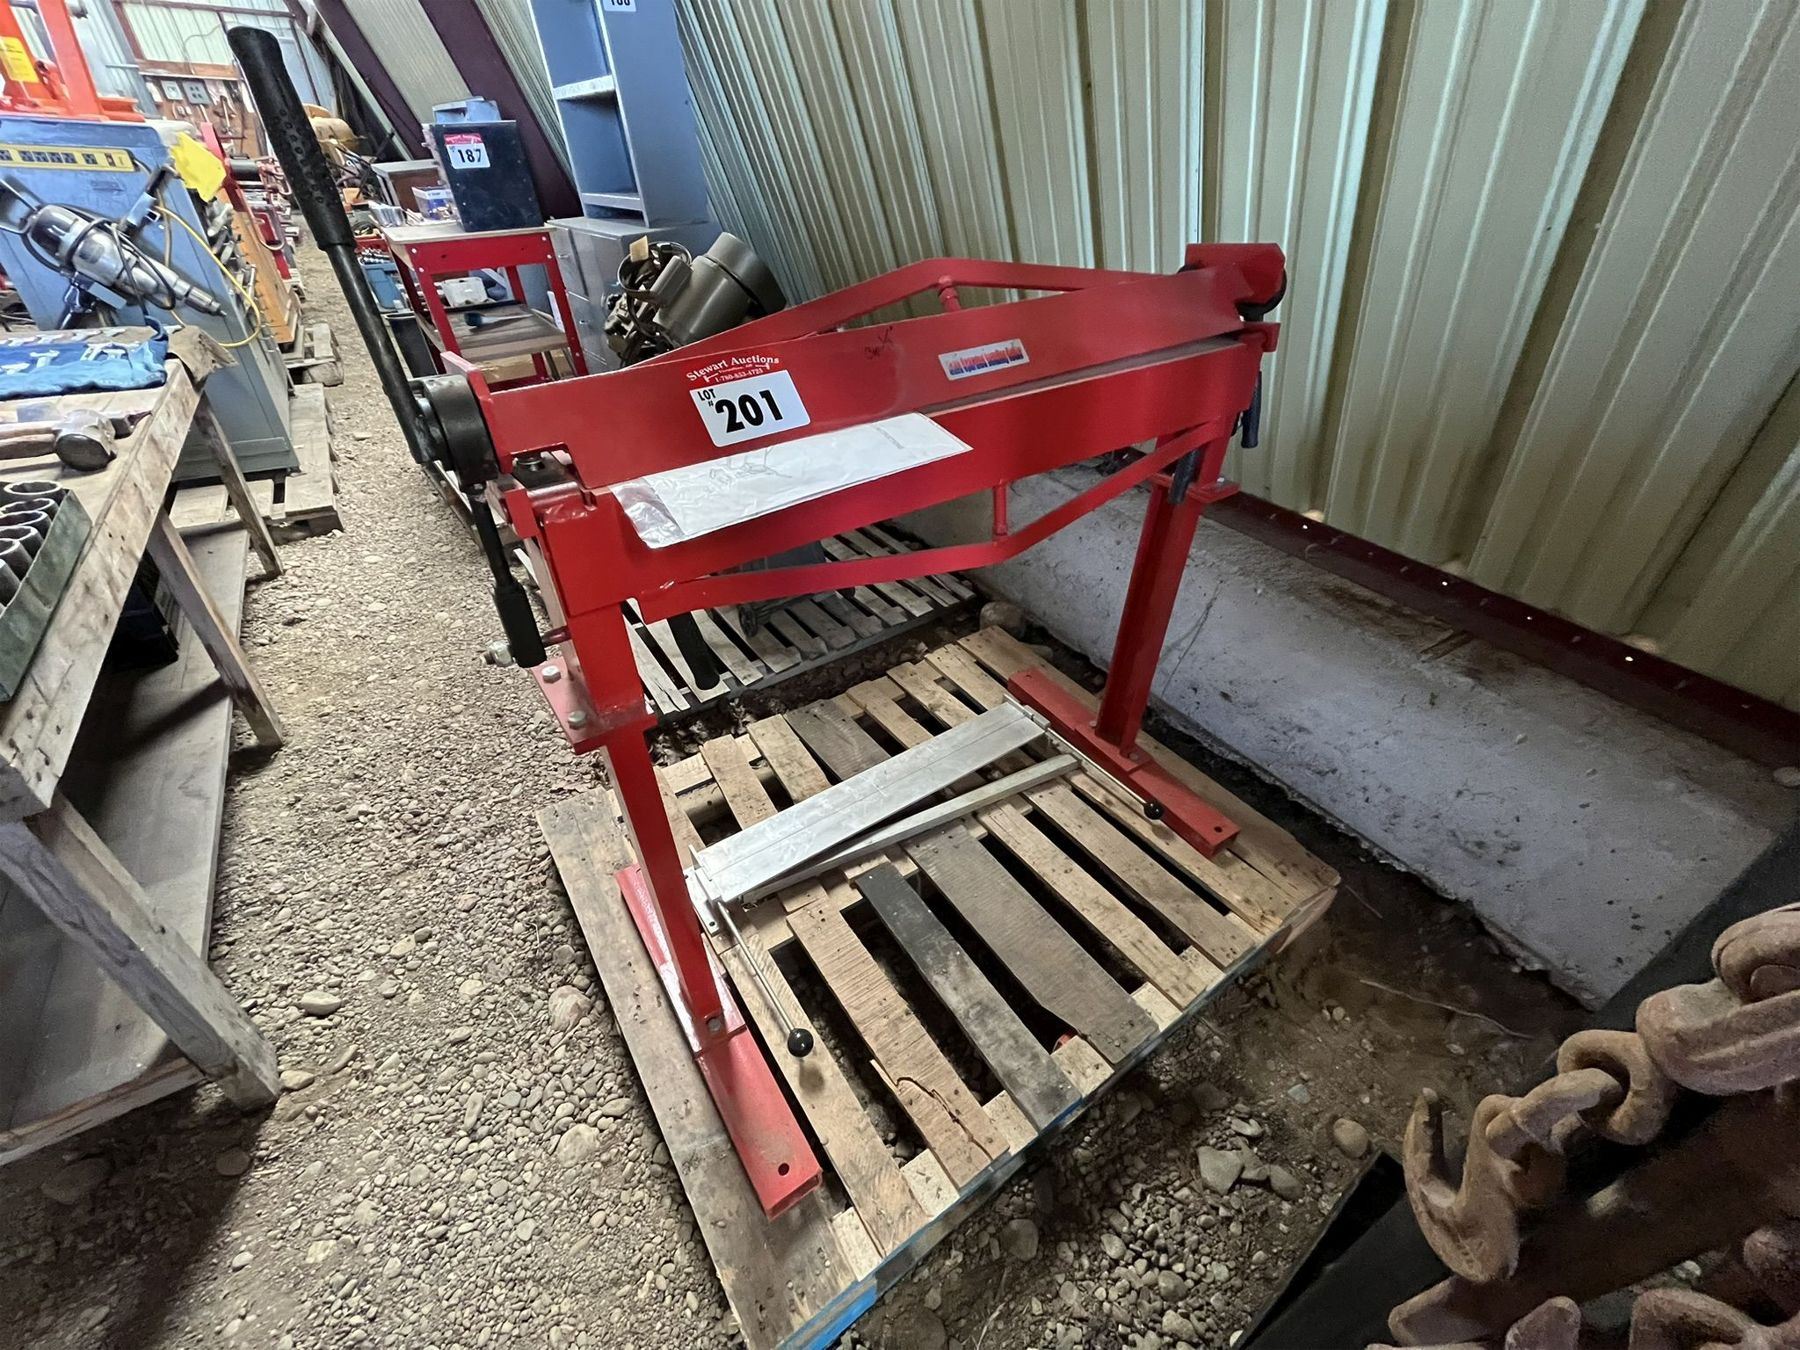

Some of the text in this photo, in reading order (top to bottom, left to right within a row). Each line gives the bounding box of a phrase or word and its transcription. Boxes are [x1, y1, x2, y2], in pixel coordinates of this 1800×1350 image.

[457, 148, 482, 163] 187
[686, 360, 728, 381] Stewart
[731, 354, 780, 366] Auctions
[697, 388, 716, 402] LOT
[714, 389, 784, 434] 201
